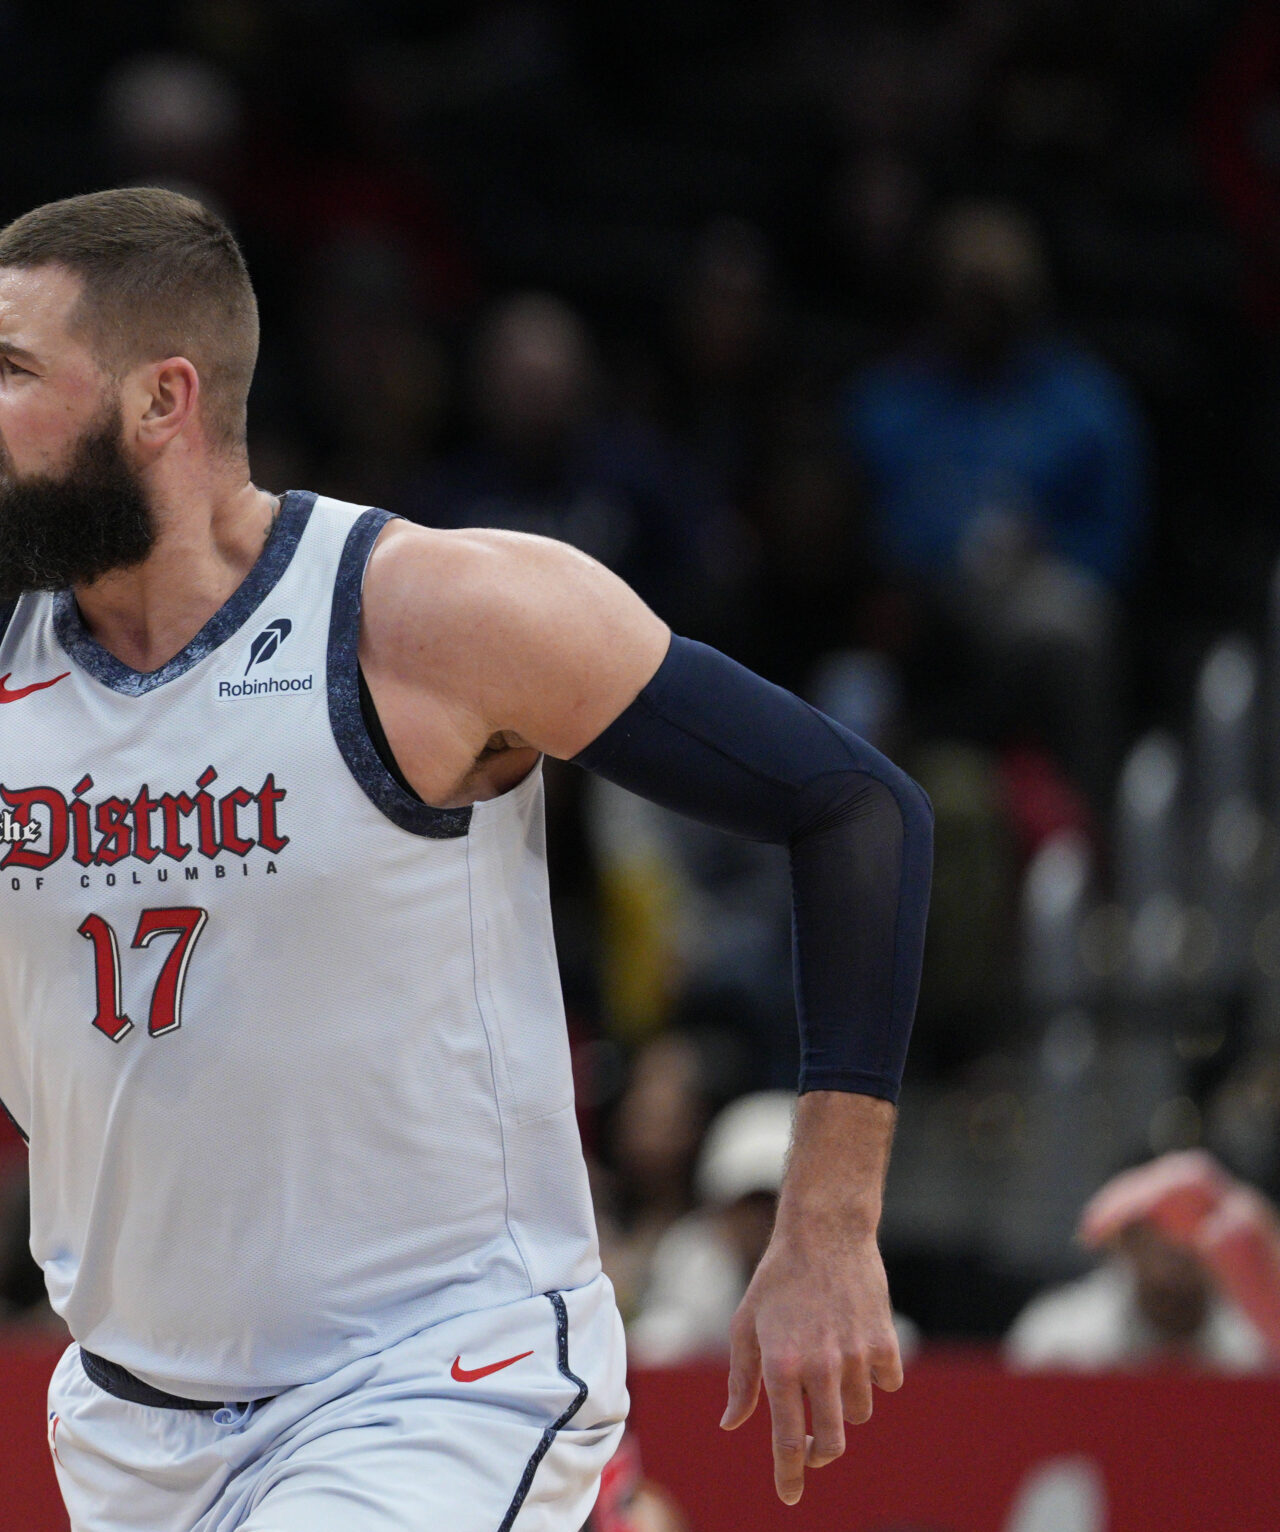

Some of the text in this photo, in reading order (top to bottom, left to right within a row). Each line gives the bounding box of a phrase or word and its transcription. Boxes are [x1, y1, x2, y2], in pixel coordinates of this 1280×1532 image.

[218, 674, 313, 698] Robinhood
[11, 860, 277, 891] OF COLUMBIA
[77, 906, 209, 1043] 17
